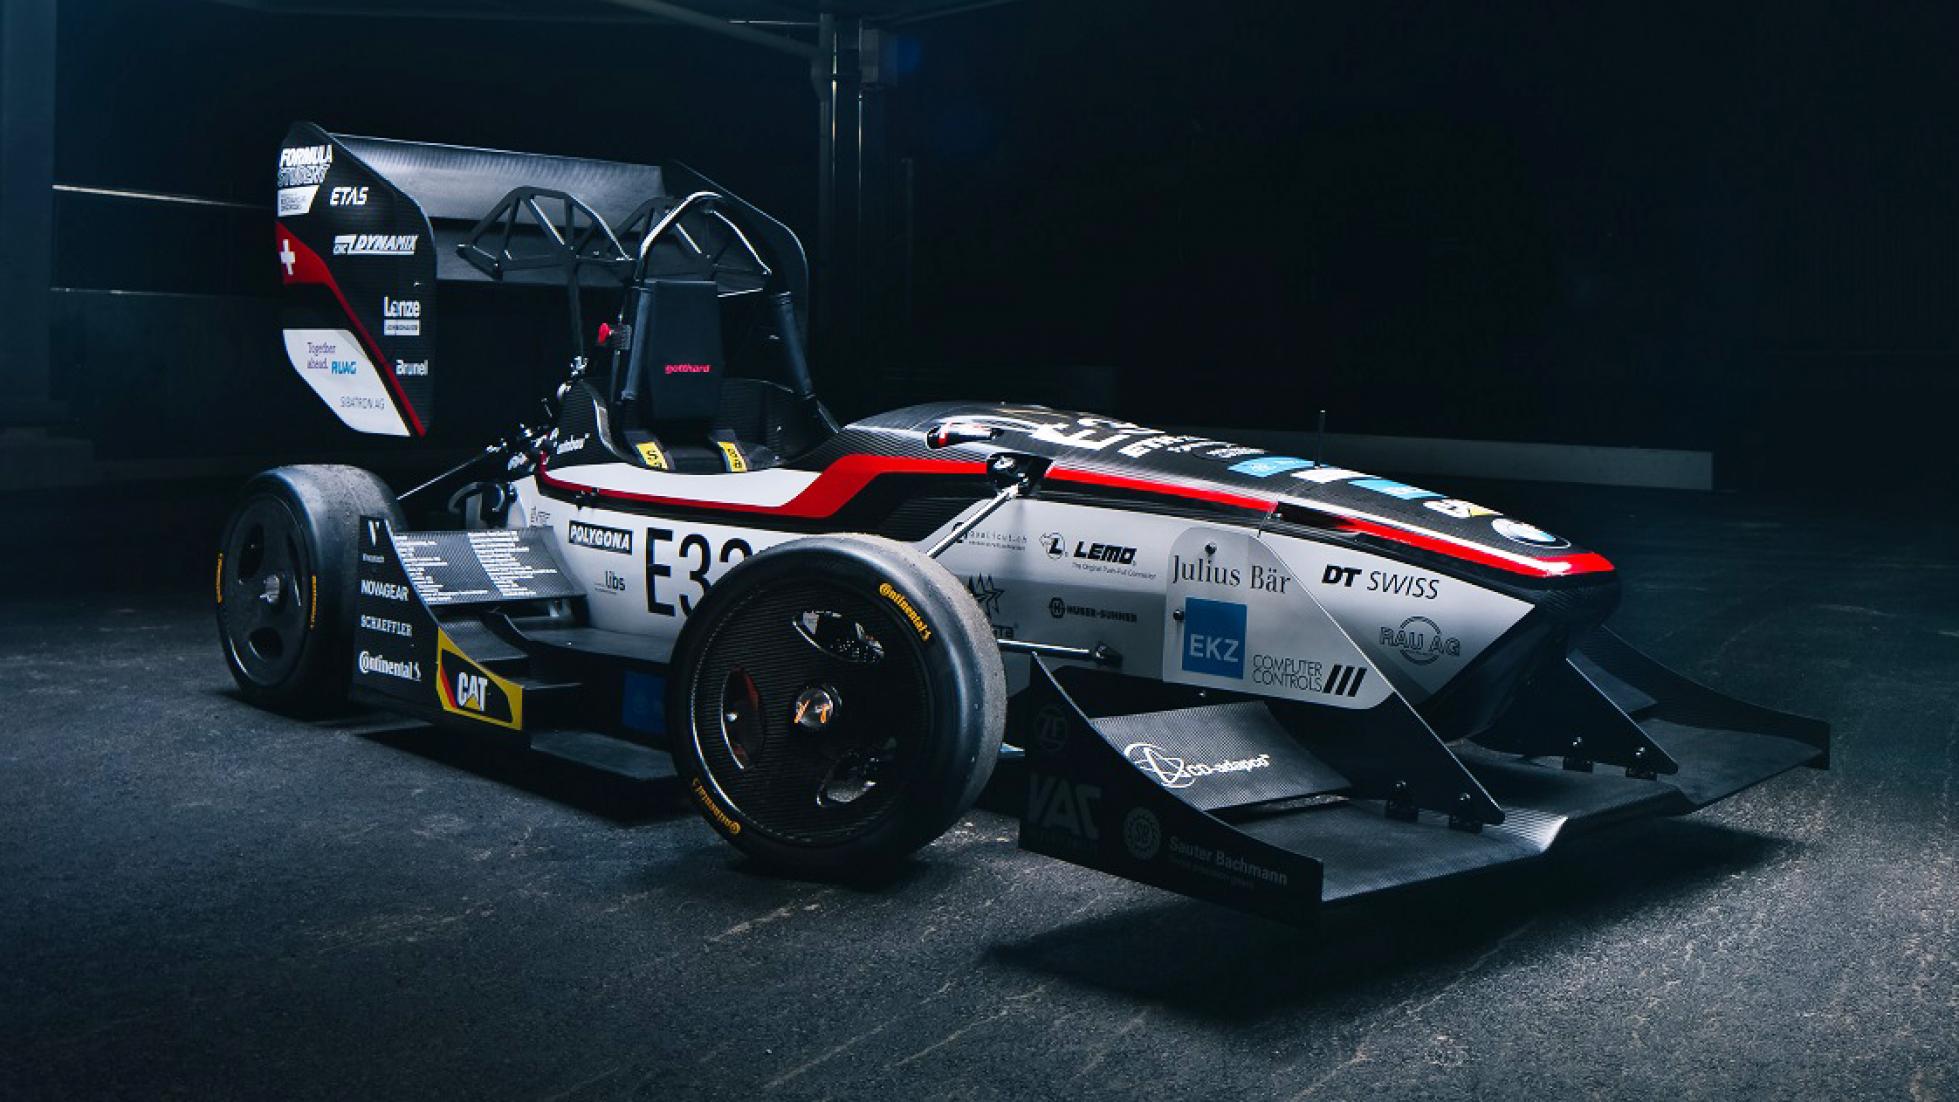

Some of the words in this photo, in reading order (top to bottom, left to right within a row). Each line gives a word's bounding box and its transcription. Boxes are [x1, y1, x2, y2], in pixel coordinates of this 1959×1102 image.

[279, 144, 333, 167] FORMULA
[329, 186, 369, 206] ETAS
[331, 360, 357, 375] RUAG
[396, 359, 429, 376] Brunel
[665, 364, 711, 375] gotthard
[569, 523, 631, 552] POLYGONA
[1073, 540, 1137, 565] LEMO
[1172, 555, 1242, 587] Julius
[1250, 564, 1291, 595] Bär
[1321, 564, 1363, 588] DT
[1367, 570, 1440, 600] SWISS
[361, 580, 409, 602] NOVAGEAR
[360, 615, 413, 637] SCHAEFFLER
[1190, 634, 1239, 663] EKZ
[1379, 626, 1425, 651] RAU
[1430, 635, 1461, 657] AG
[1252, 654, 1323, 677] COMPUTER
[458, 672, 488, 712] CAT
[1252, 668, 1323, 692] CONTROLS
[1168, 835, 1213, 862] Sauter
[1216, 850, 1288, 886] Bachmann
